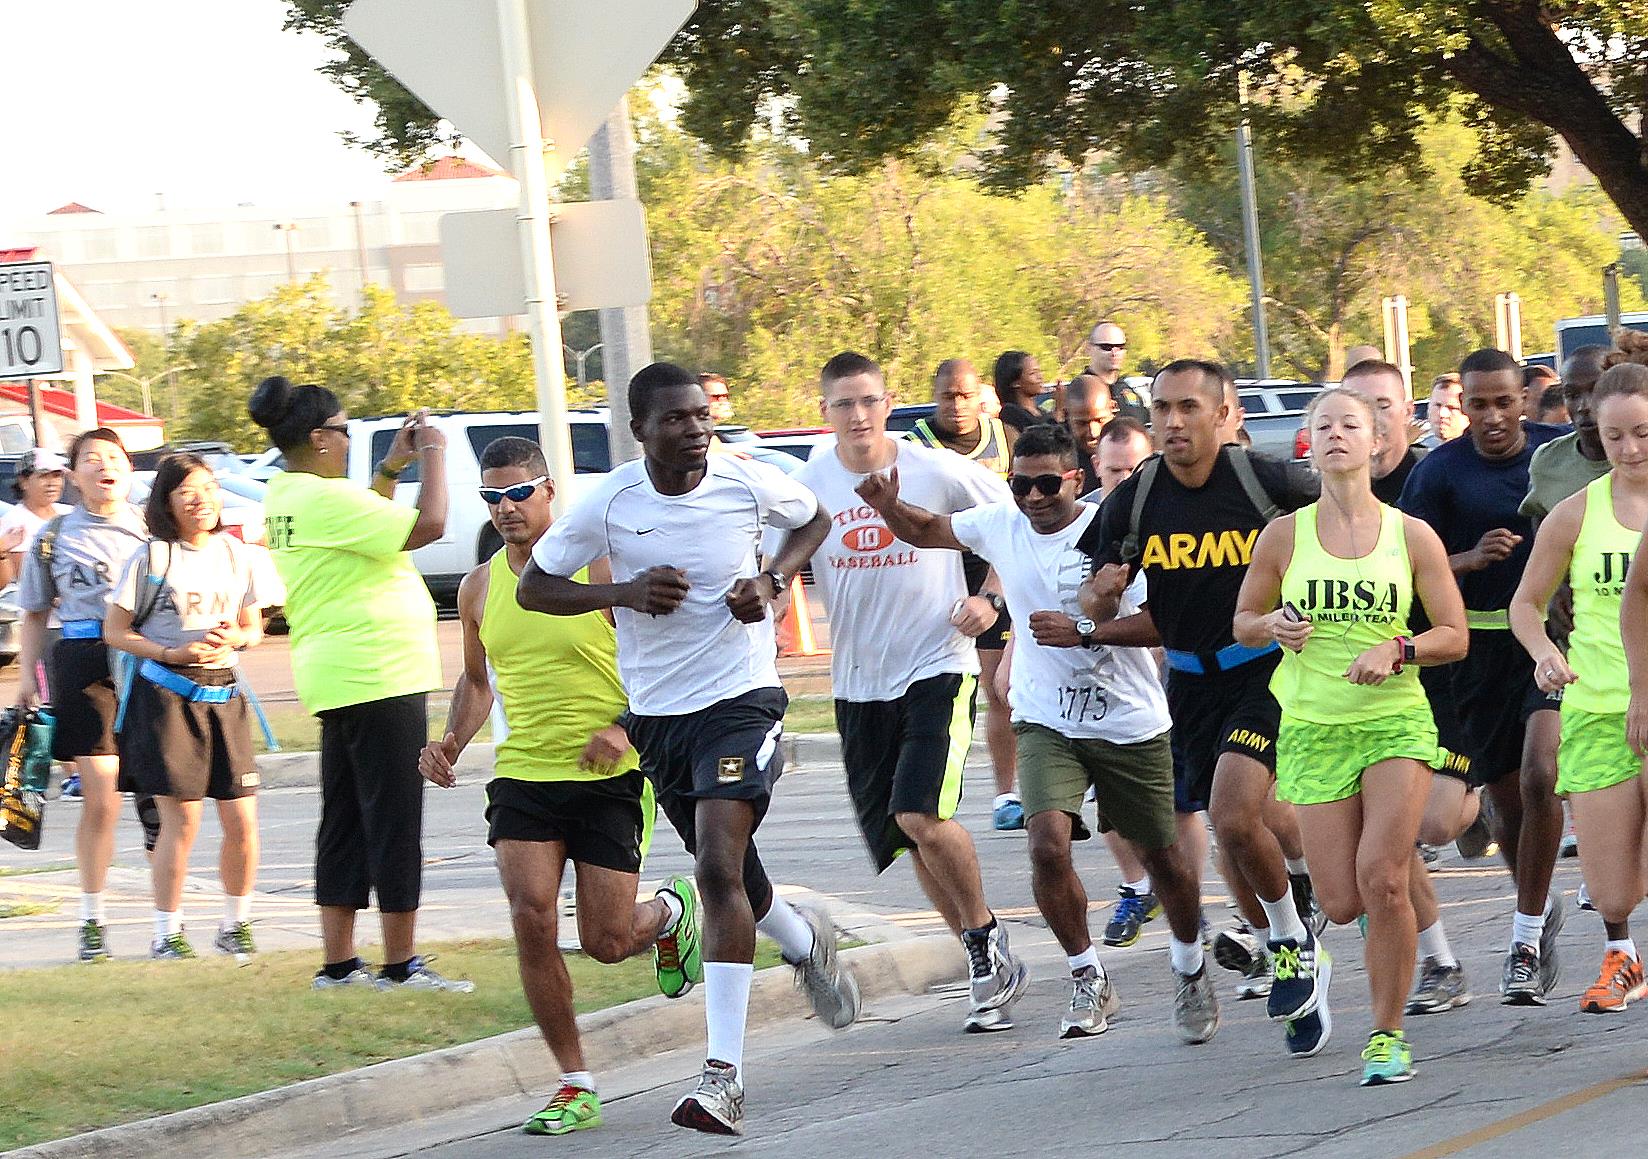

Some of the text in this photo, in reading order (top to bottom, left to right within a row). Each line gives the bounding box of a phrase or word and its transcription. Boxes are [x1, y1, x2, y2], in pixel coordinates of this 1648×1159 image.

[3, 325, 42, 366] 10
[833, 504, 880, 526] TIG
[857, 526, 880, 552] 10
[1142, 528, 1259, 570] ARMY
[1300, 579, 1397, 612] JBSA
[1226, 728, 1271, 752] ARMY
